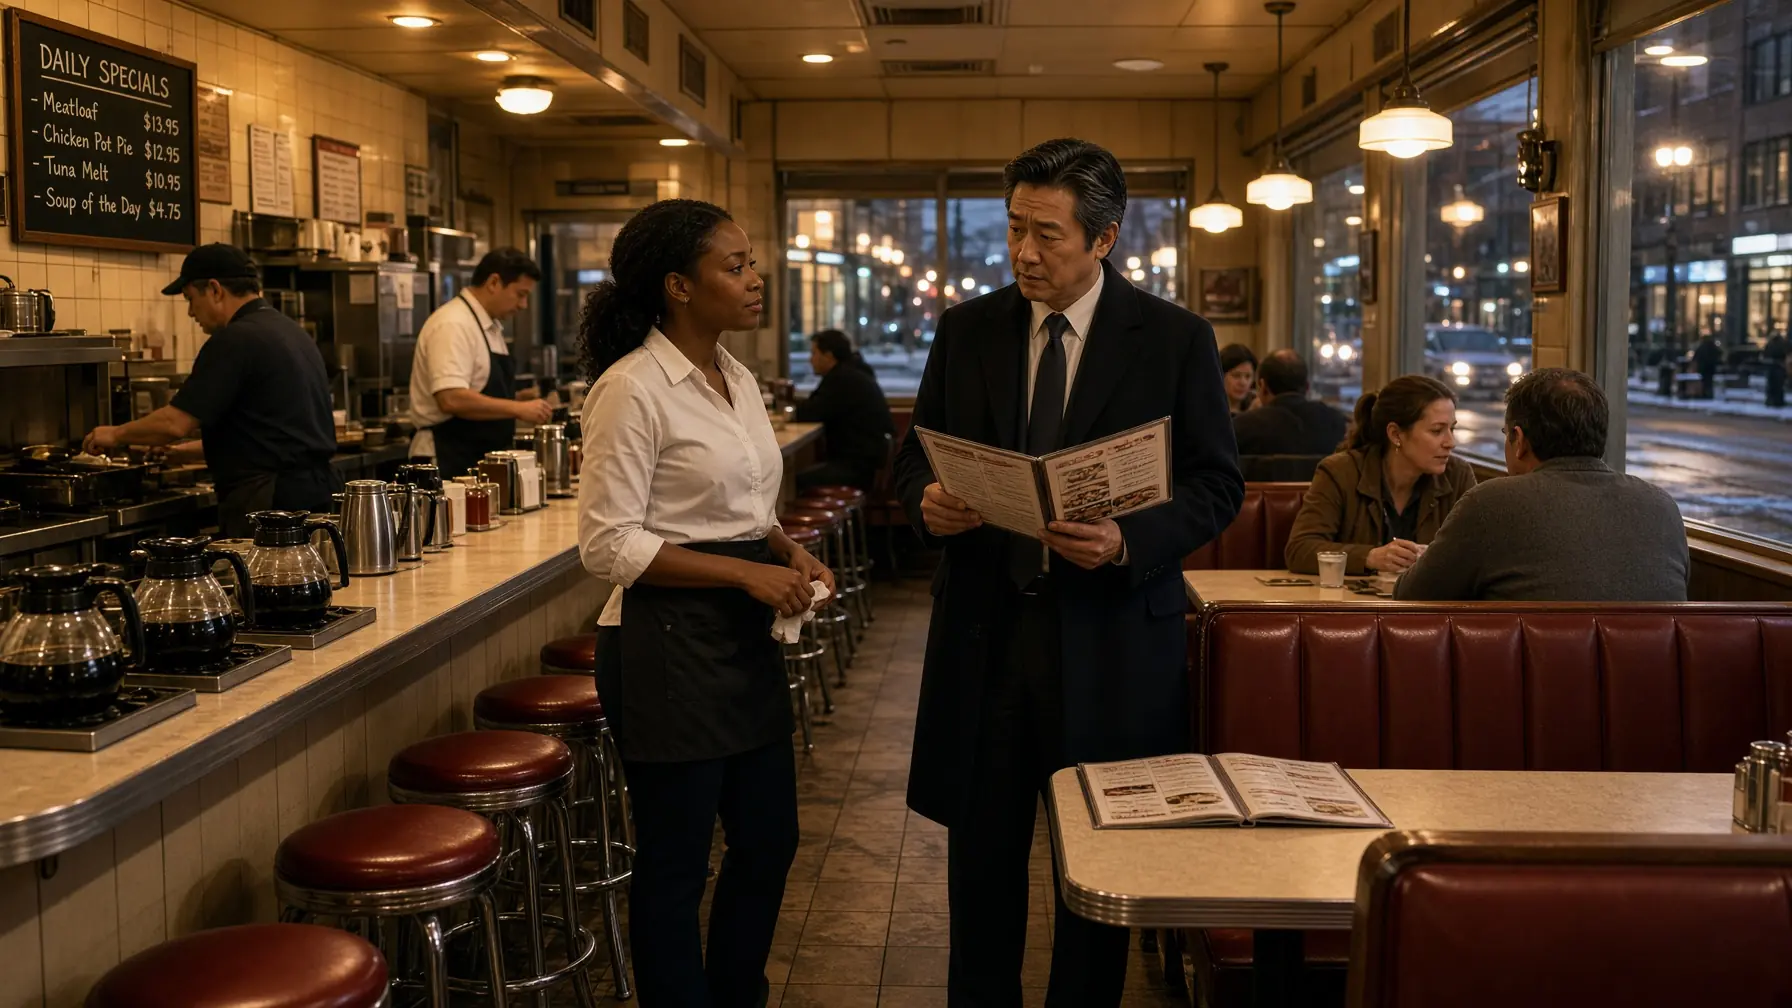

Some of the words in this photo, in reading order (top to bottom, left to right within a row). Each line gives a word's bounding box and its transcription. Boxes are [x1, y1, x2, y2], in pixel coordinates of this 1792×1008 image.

[39, 43, 90, 79] DAILY
[98, 59, 170, 99] SPECIALS
[43, 91, 99, 121] Meatloaf
[143, 111, 180, 136] $13.95
[43, 123, 90, 149] Chicken
[94, 131, 112, 153] Pot
[117, 135, 134, 156] Pie
[144, 140, 180, 164] $12.95
[43, 155, 77, 178] Tuna
[82, 160, 109, 182] Melt
[145, 169, 181, 191] $10.95
[46, 186, 77, 216] Soup
[81, 191, 94, 215] of
[98, 194, 117, 213] the
[121, 195, 142, 222] Day
[148, 198, 181, 220] $4.75
